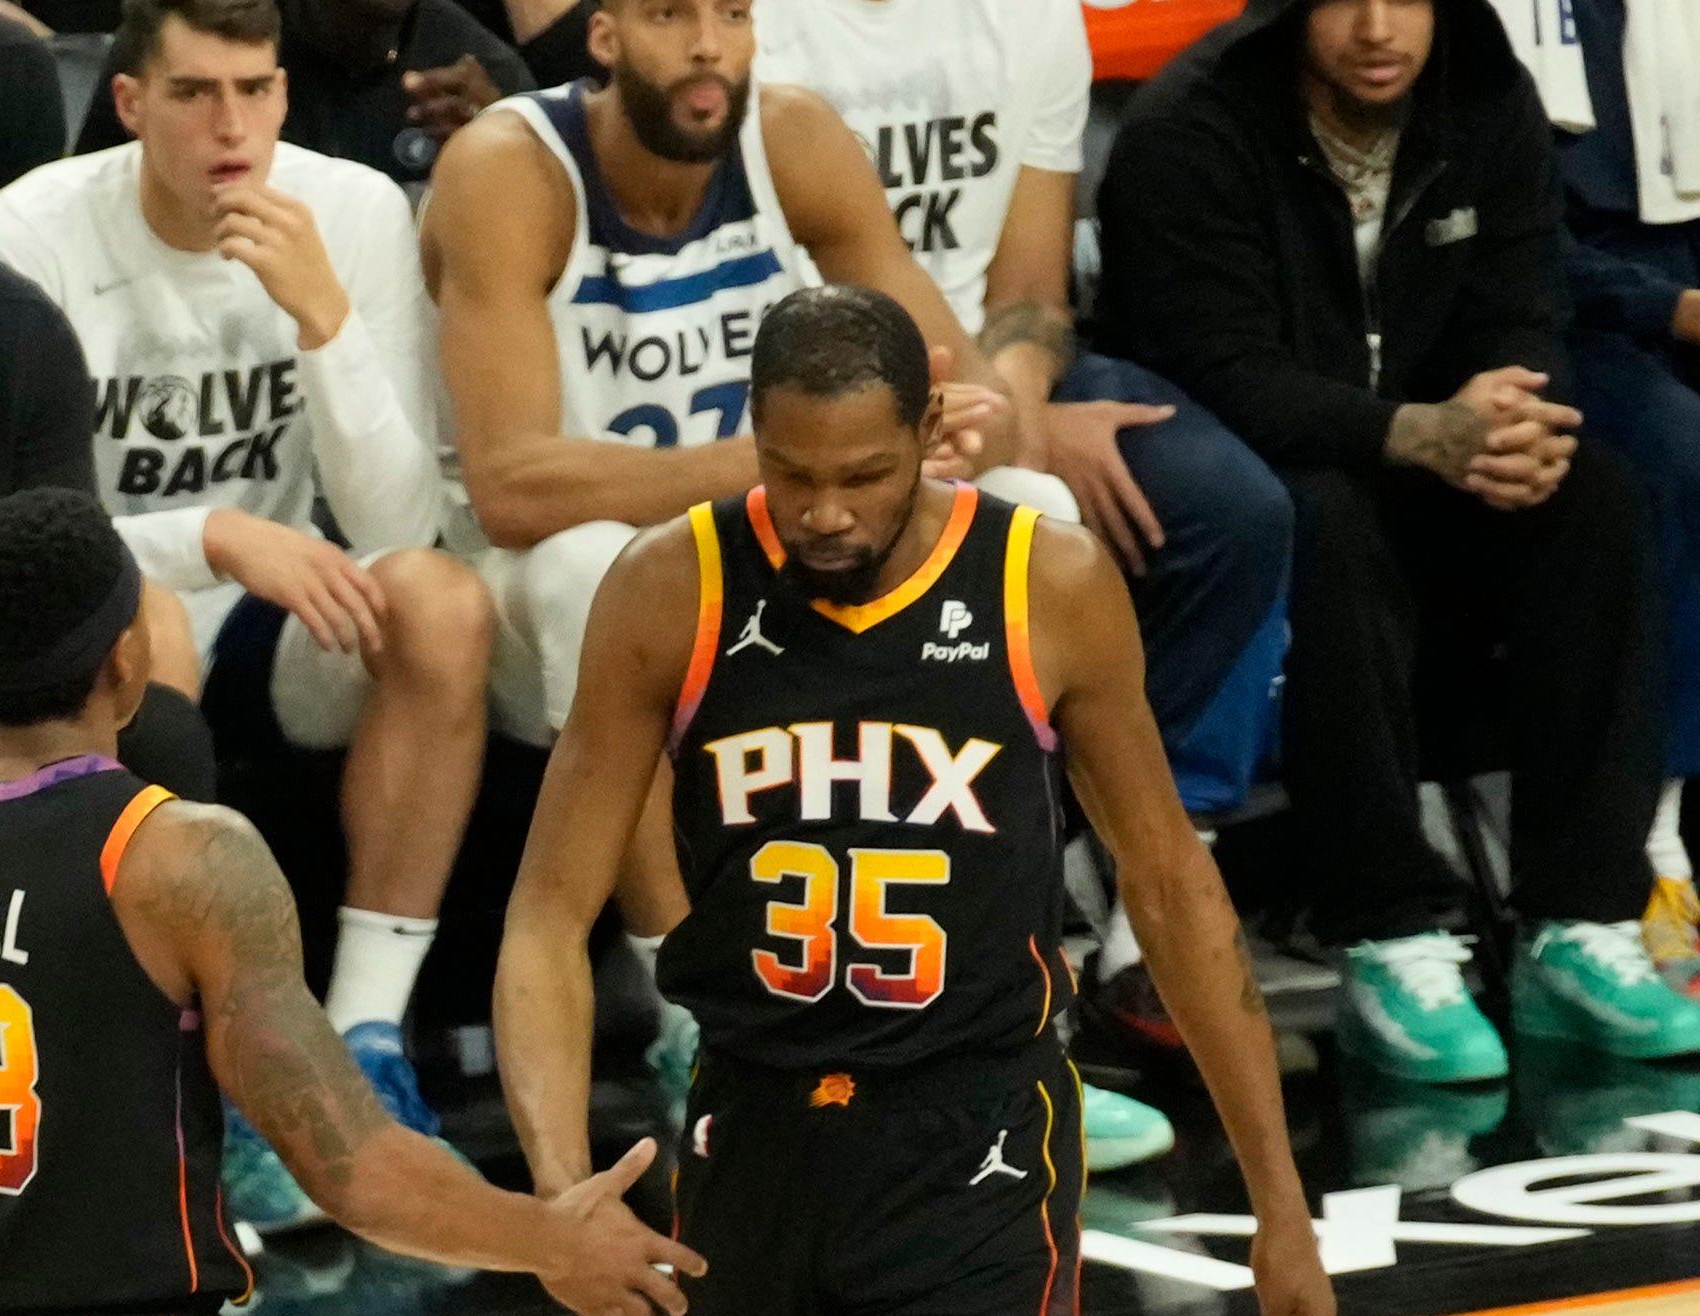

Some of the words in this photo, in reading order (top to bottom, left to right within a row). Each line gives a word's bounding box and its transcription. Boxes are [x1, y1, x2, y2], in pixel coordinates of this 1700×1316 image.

[874, 111, 999, 188] LVES
[117, 423, 289, 496] BACK
[921, 641, 990, 663] PayPal
[702, 719, 1004, 834] PHX
[749, 839, 951, 1010] 35
